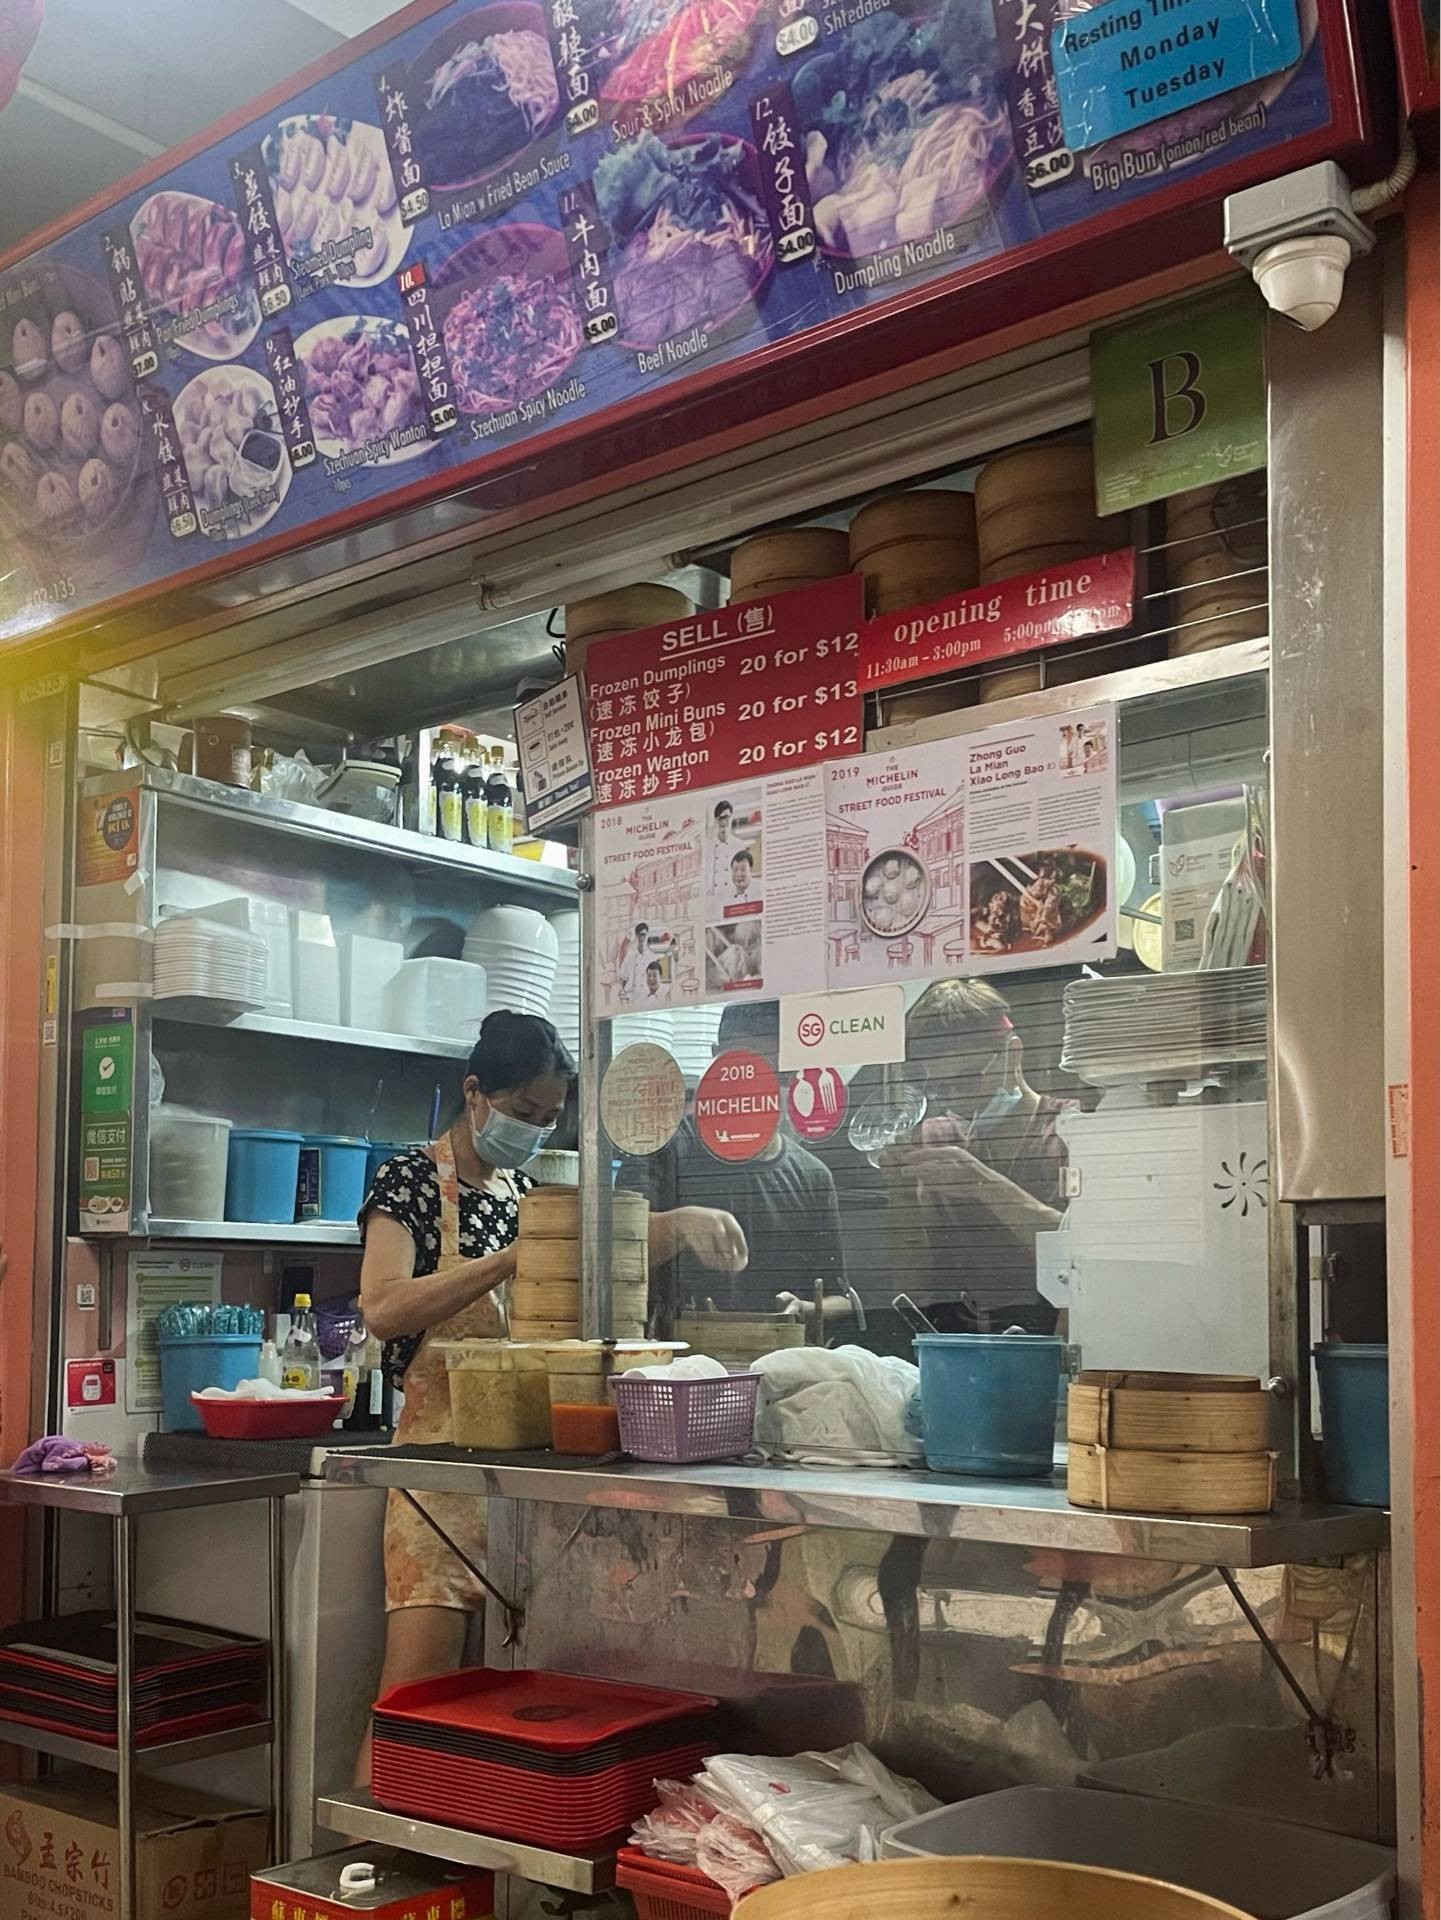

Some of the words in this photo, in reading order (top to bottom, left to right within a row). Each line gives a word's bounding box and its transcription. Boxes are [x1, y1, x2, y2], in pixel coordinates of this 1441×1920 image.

[1064, 9, 1142, 54] Resting
[1119, 17, 1220, 72] Monday
[612, 115, 641, 143] Sour
[642, 111, 653, 132] &
[655, 90, 687, 125] Spicy
[688, 67, 733, 105] Noodle
[1124, 58, 1226, 109] Tuesday
[1090, 162, 1119, 192] Big
[1121, 150, 1157, 176] Bun
[1229, 104, 1267, 137] bean)
[487, 175, 513, 206] Fried
[513, 166, 540, 193] Bean
[540, 151, 571, 184] Sauce
[763, 116, 805, 232] 饺子面
[291, 240, 328, 280] Steamed
[327, 227, 373, 261] Dumpling
[571, 213, 608, 312] 牛肉面
[777, 230, 814, 259] $4.00
[835, 255, 903, 295] Dumpling
[903, 227, 956, 267] Noodle
[400, 270, 414, 292] 10.
[407, 288, 448, 402] 四川担担面
[637, 343, 665, 375] Beef
[665, 327, 709, 368] Noodle
[470, 410, 519, 440] Szechuan
[518, 397, 546, 424] Spicy
[546, 378, 586, 410] Noodle
[1146, 351, 1207, 447] B
[323, 446, 365, 476] Szechuan
[364, 435, 391, 464] Spicy
[391, 423, 428, 452] Wanton
[662, 620, 728, 652] SELL
[738, 604, 773, 633] (售)
[893, 595, 1003, 646] opening
[1026, 573, 1092, 608] time
[590, 676, 639, 699] Frozen
[643, 654, 726, 686] Dumplings
[740, 654, 767, 676] 20
[775, 647, 809, 667] for
[816, 632, 859, 658] $12
[866, 654, 919, 680] 11:30am
[933, 639, 982, 662] 3:00pm
[646, 709, 679, 732] Mini
[683, 701, 726, 723] Buns
[738, 701, 765, 721] 20
[772, 694, 808, 714] for
[815, 681, 858, 705] $13
[646, 748, 710, 773] Wanton
[739, 745, 766, 765] 20
[772, 739, 808, 758] for
[815, 726, 858, 751] $12
[969, 749, 1003, 764] Zhong
[1005, 744, 1027, 756] Guo
[969, 764, 982, 775] La
[984, 759, 1009, 773] Mian
[831, 766, 860, 781] 2019
[866, 769, 919, 787] MICHELIN
[969, 774, 993, 786] Xiao
[995, 769, 1021, 782] Long
[1023, 764, 1045, 776] Bao
[838, 800, 873, 814] STREET
[875, 795, 902, 808] FOOD
[903, 787, 947, 804] FESTIVAL
[626, 819, 669, 836] MICHELIN
[604, 851, 631, 865] STREET
[632, 847, 655, 859] FOOD
[656, 841, 693, 856] FESTIVAL
[801, 1022, 821, 1038] SG
[829, 1015, 885, 1035] CLEAN
[719, 1065, 755, 1082] 2018
[697, 1094, 780, 1118] MICHELIN
[87, 1127, 127, 1145] 微信支付
[48, 1879, 113, 1912] CHOPSTICKS
